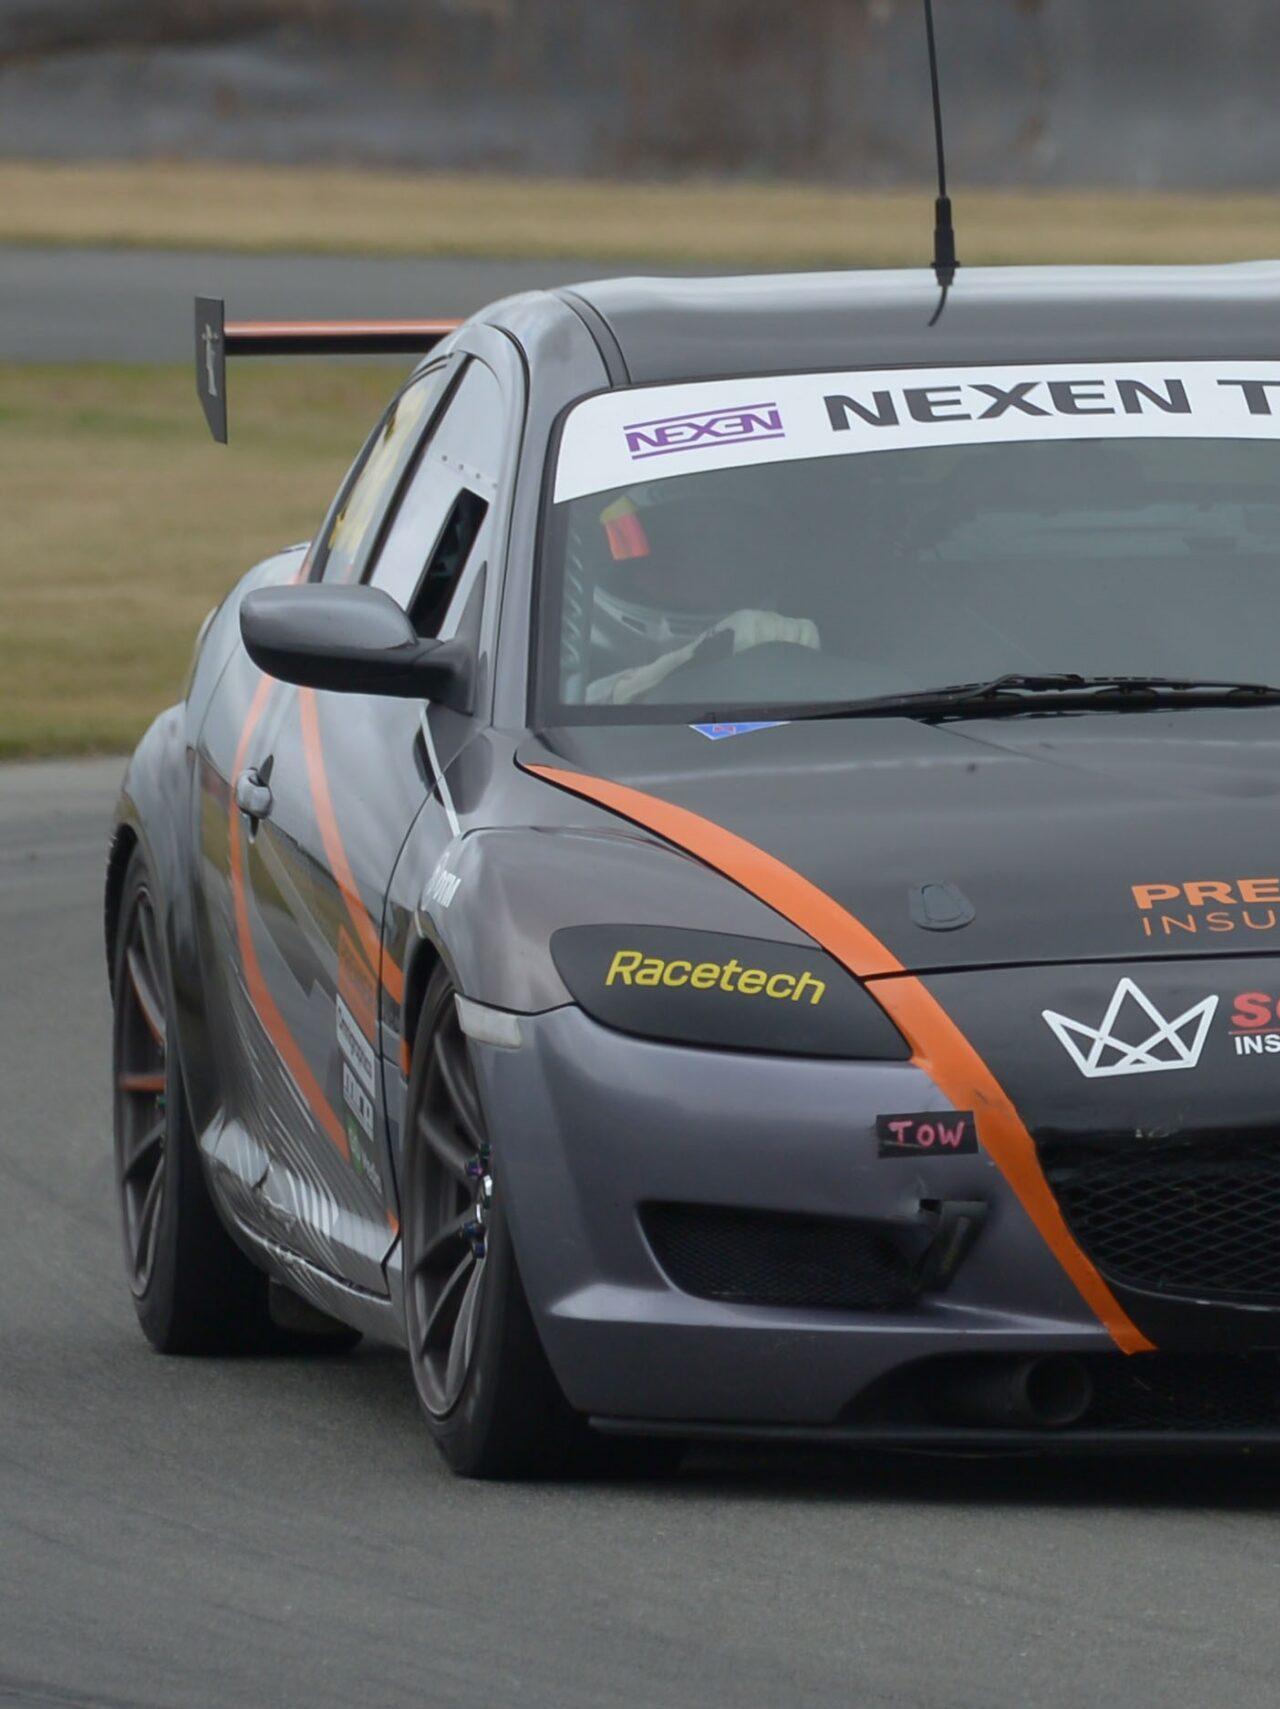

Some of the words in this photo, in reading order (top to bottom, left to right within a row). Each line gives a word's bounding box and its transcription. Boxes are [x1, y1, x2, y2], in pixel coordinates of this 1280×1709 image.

[824, 380, 1192, 431] NEXEN
[624, 411, 784, 453] NEXEN
[606, 950, 826, 1004] Racetech
[889, 1121, 965, 1148] TOW
